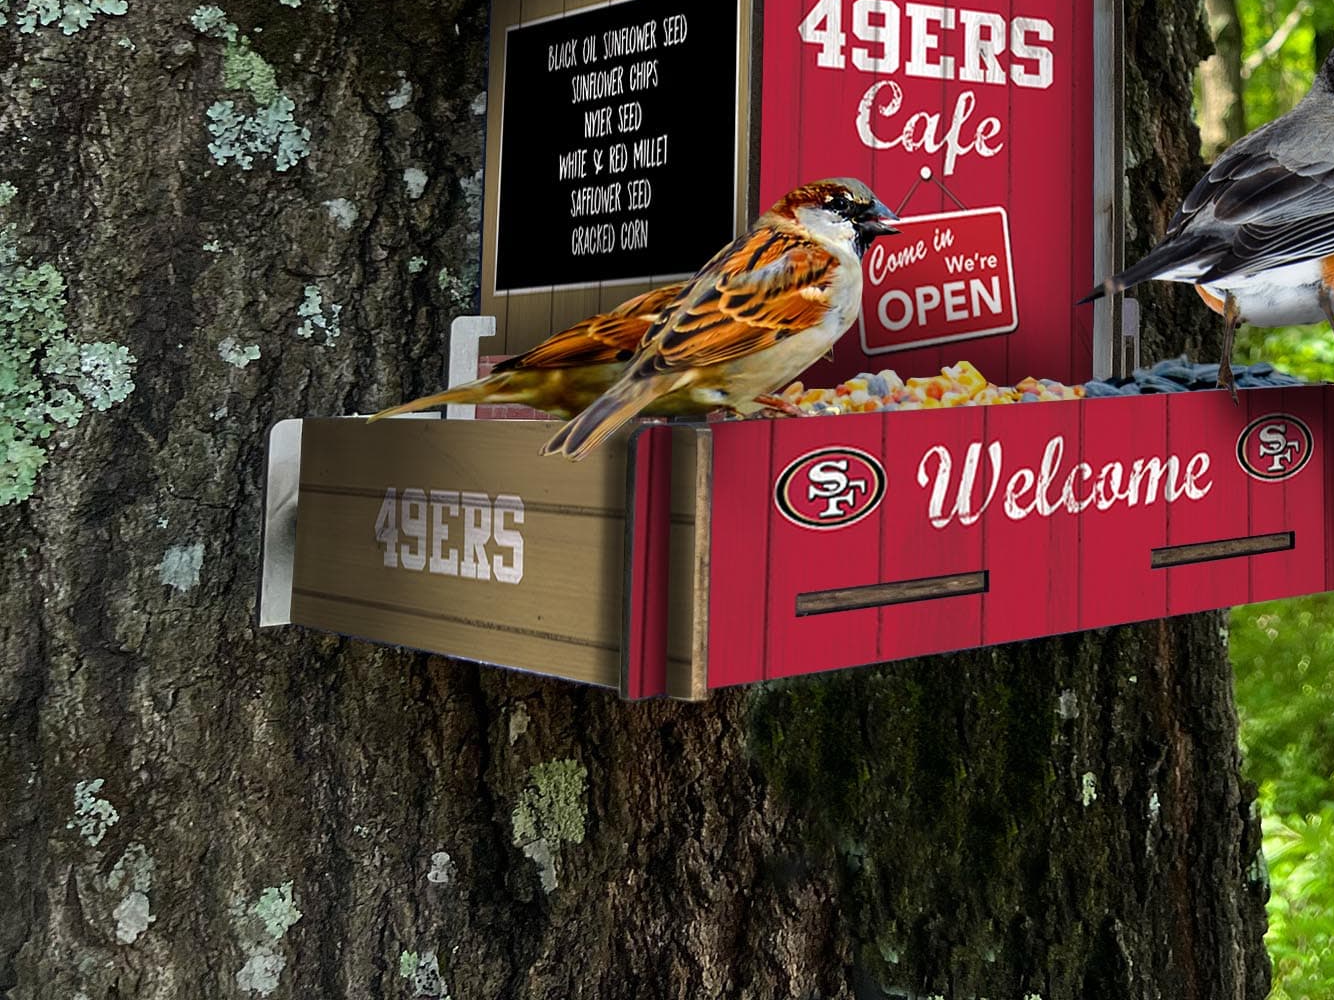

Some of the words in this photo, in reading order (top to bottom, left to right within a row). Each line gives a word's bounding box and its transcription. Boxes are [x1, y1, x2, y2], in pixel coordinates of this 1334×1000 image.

[548, 41, 577, 72] BLACK
[583, 35, 598, 63] OIL
[604, 20, 657, 61] SUNFLOWER
[663, 14, 688, 47] SEED
[572, 66, 624, 104] SUNFLOWER
[630, 60, 659, 91] CHIPS
[584, 108, 612, 139] NYJER
[618, 102, 642, 131] SEED
[856, 80, 1003, 176] Cafe
[559, 149, 587, 181] WHITE
[594, 148, 603, 175] &
[609, 144, 628, 174] RED
[633, 134, 669, 168] MILLET
[570, 182, 621, 217] SAFFLOWER
[627, 178, 651, 210] SEED
[571, 224, 615, 256] CRACKED
[621, 219, 648, 249] CORN
[868, 237, 927, 286] Come
[932, 227, 954, 253] in
[944, 252, 998, 274] We're
[877, 275, 1003, 332] OPEN
[1258, 423, 1300, 473] SF
[806, 459, 868, 518] SF
[917, 435, 1215, 528] Welcome
[374, 487, 525, 585] 49ERS
